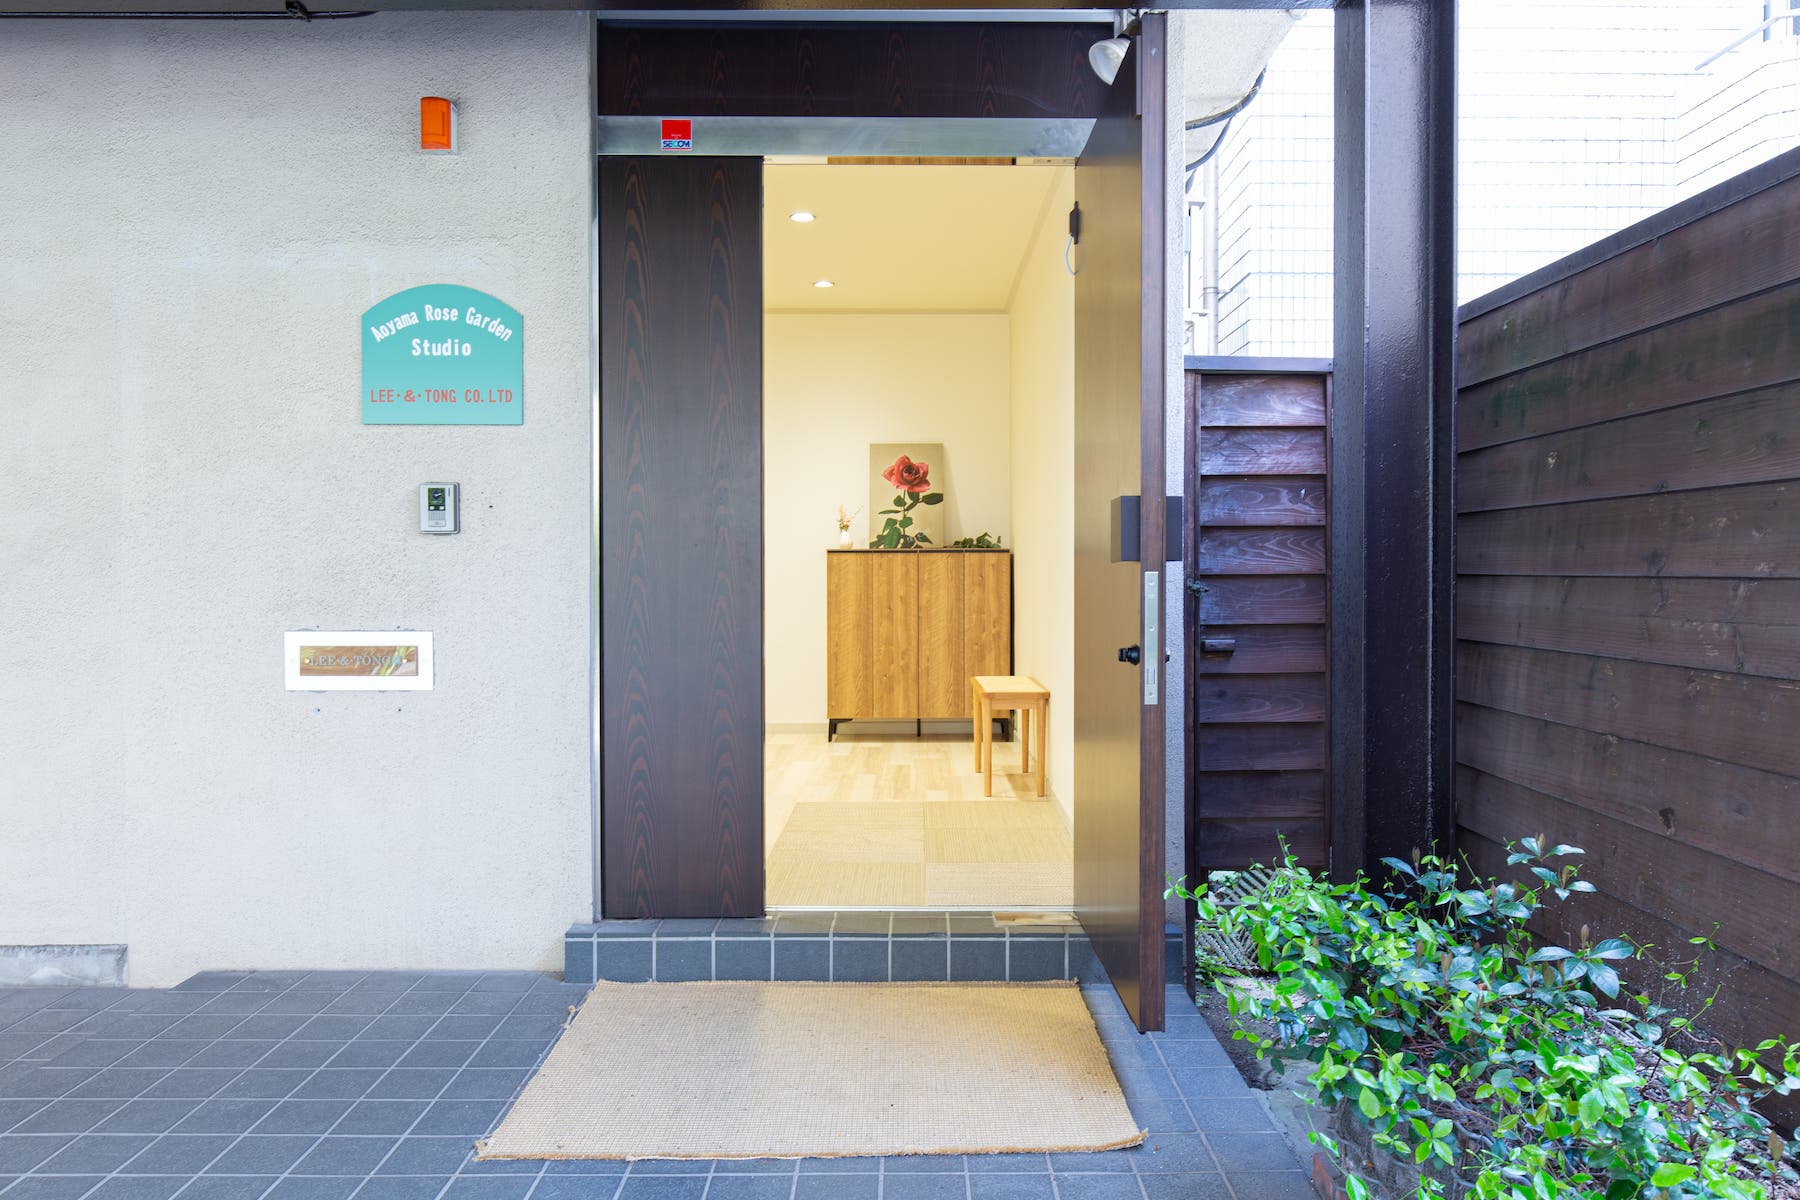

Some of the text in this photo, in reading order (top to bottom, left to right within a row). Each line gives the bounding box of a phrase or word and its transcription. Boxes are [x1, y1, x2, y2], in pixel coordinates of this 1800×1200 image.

[663, 140, 690, 148] SECOM
[370, 304, 513, 343] Aoyama Rose Garden
[411, 338, 472, 356] Studio
